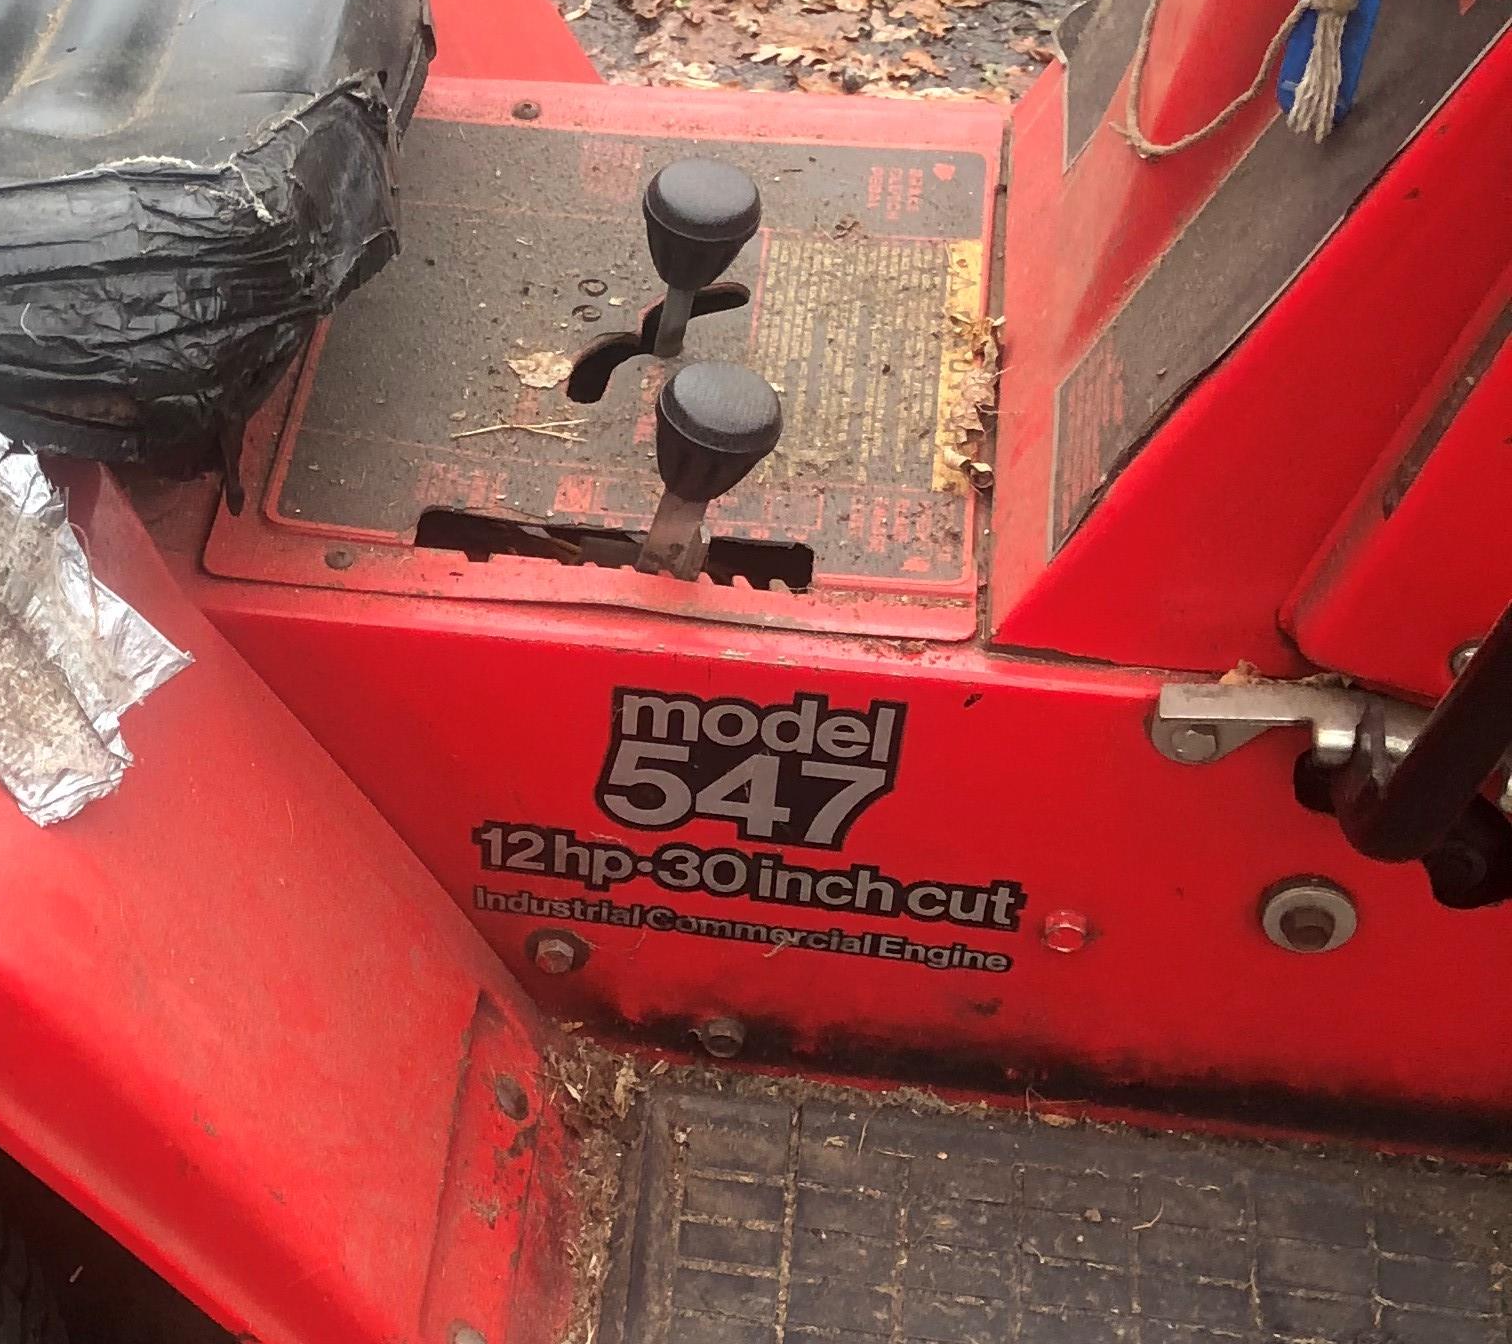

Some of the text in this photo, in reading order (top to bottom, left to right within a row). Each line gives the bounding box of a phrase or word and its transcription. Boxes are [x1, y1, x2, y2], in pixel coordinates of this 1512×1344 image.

[621, 694, 896, 763] model
[603, 739, 887, 845] 547
[475, 886, 1009, 972] Industrial Commercial Engine
[758, 858, 895, 913] inch
[906, 886, 1016, 926] cut
